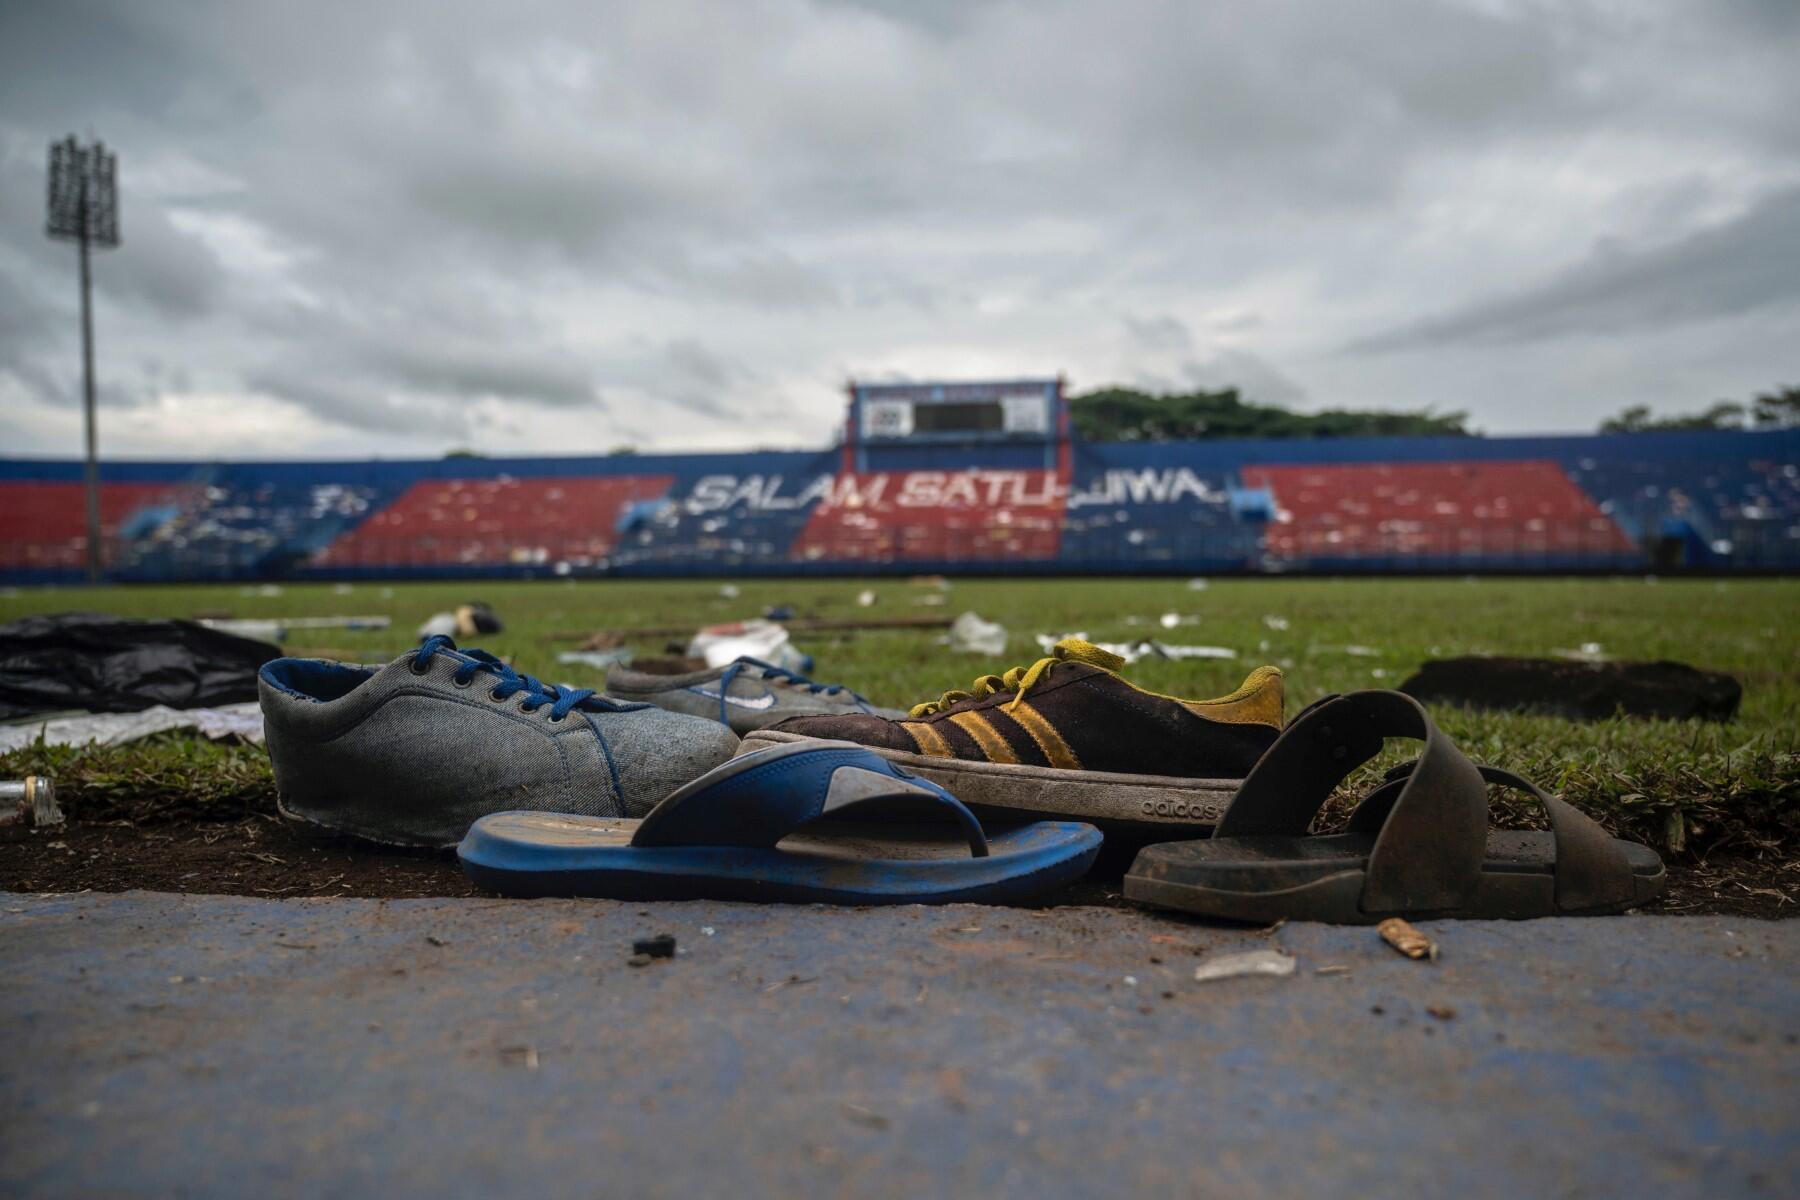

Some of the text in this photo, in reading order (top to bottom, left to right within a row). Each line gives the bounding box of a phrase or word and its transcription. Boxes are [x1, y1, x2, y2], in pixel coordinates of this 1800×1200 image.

[686, 466, 1226, 512] SALAM SATU JIWA
[1141, 798, 1219, 820] adidas
